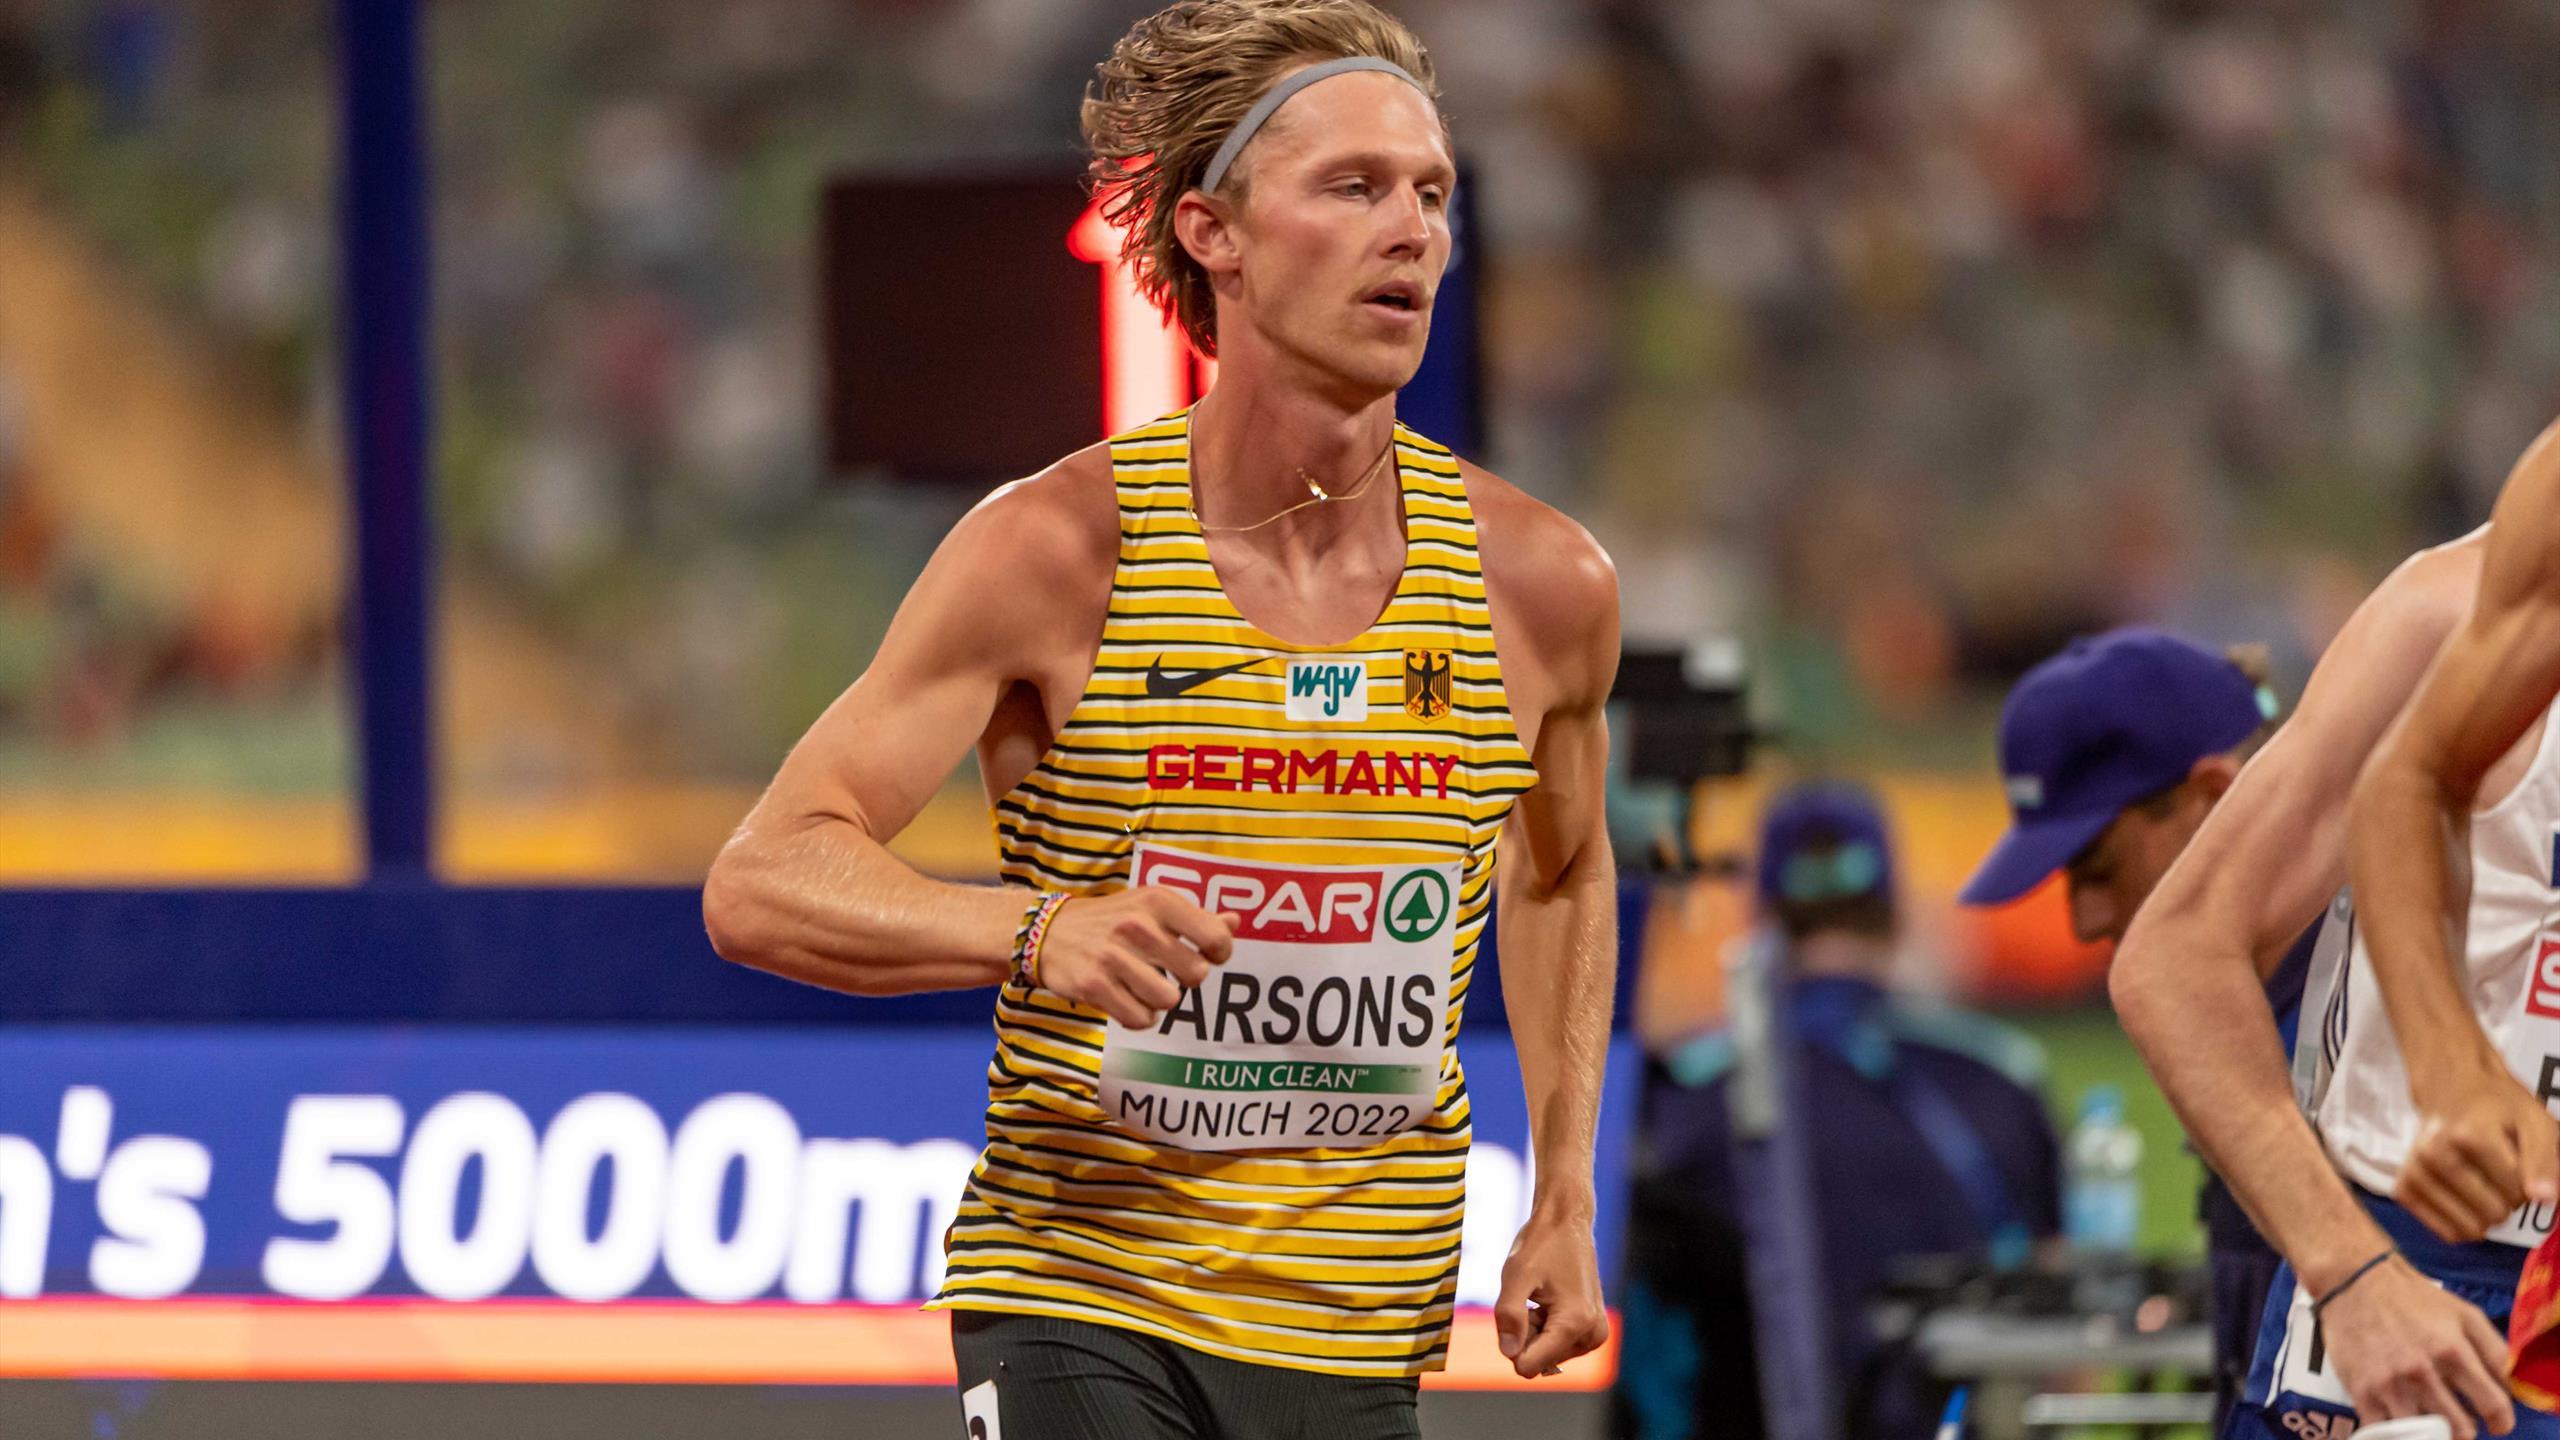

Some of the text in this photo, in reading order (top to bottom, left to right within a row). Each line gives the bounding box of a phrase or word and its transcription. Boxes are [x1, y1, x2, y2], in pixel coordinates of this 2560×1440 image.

[1147, 744, 1460, 800] GERMANY
[1153, 966, 1436, 1049] ARSONS
[1184, 1061, 1193, 1084] I
[1201, 1064, 1262, 1088] RUN
[1119, 1089, 1411, 1138] MUNICH 2022
[262, 1091, 980, 1304] 5000m
